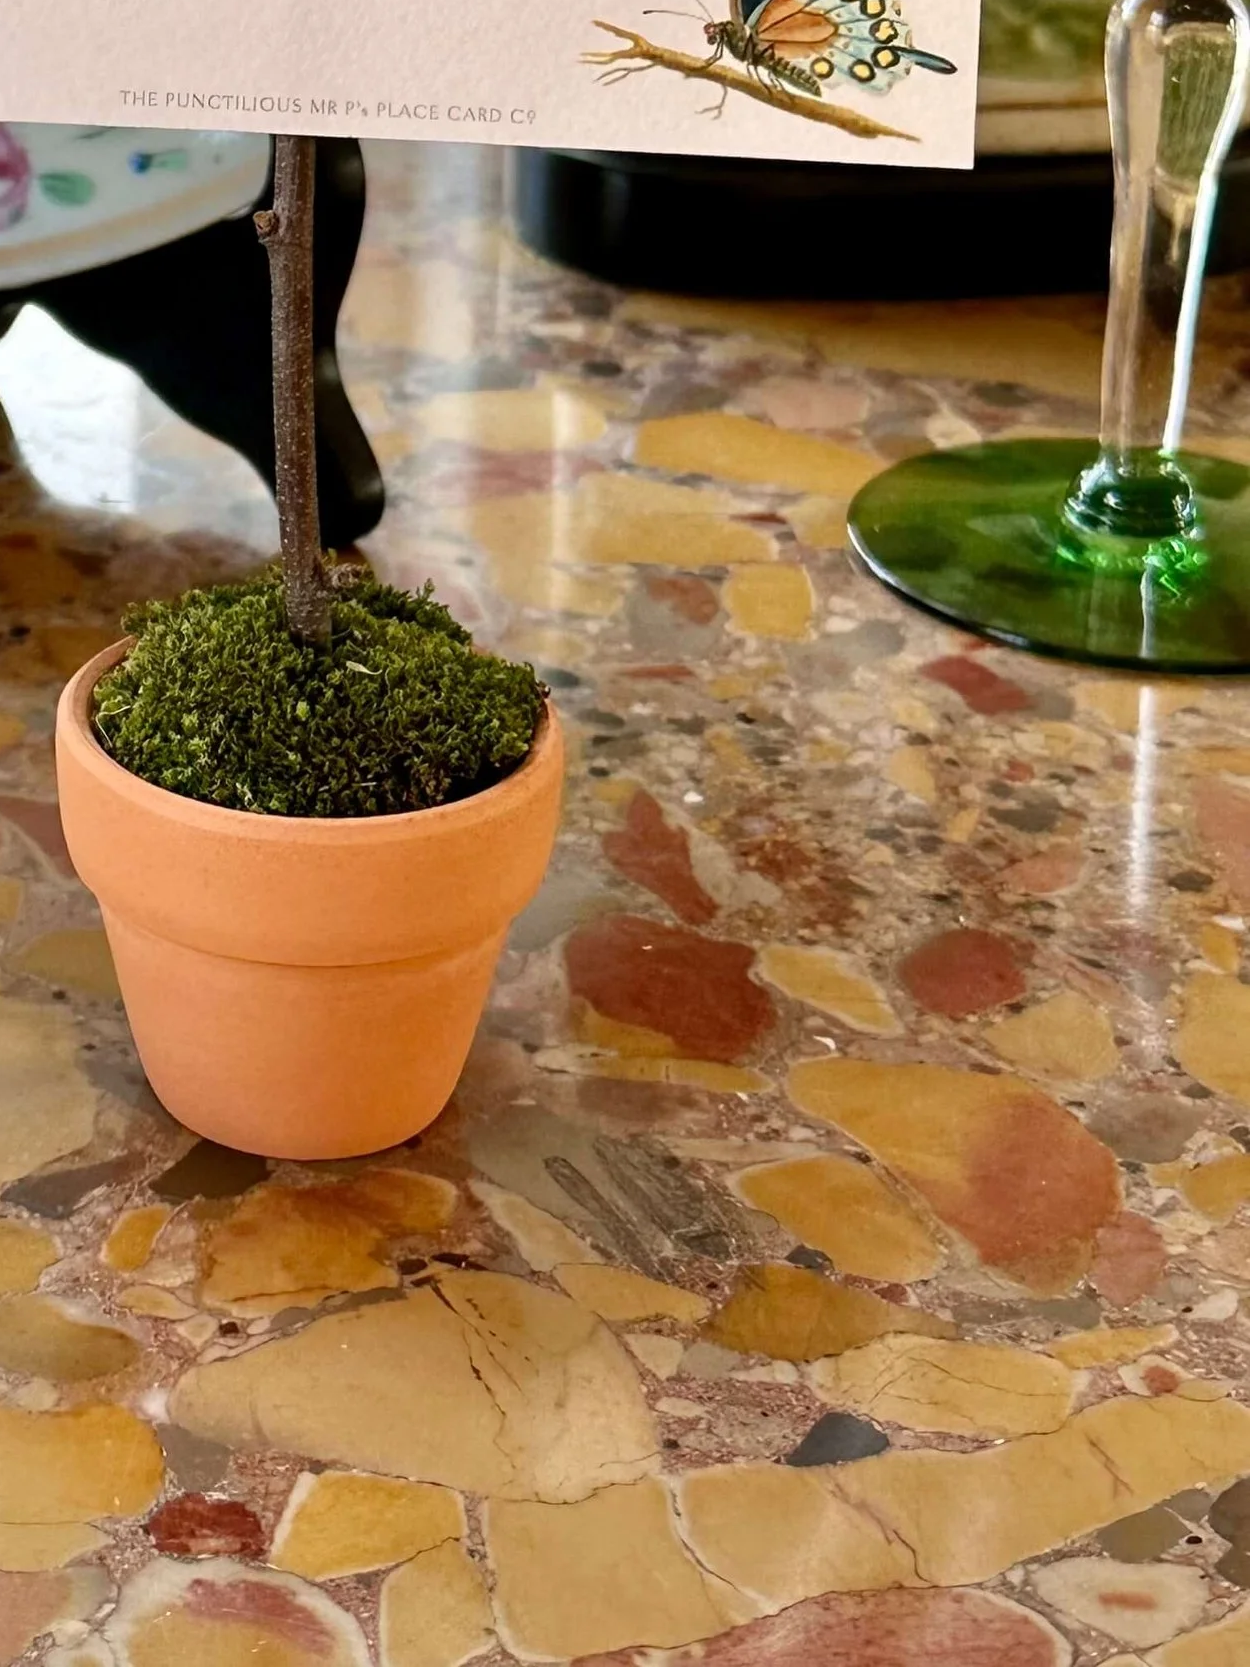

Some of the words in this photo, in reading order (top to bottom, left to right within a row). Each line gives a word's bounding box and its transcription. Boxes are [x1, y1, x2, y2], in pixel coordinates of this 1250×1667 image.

[120, 90, 158, 106] THE
[166, 92, 302, 113] PUNCTILIOUS
[310, 98, 338, 116] MR
[377, 101, 440, 121] PLACE
[447, 105, 502, 123] CARD
